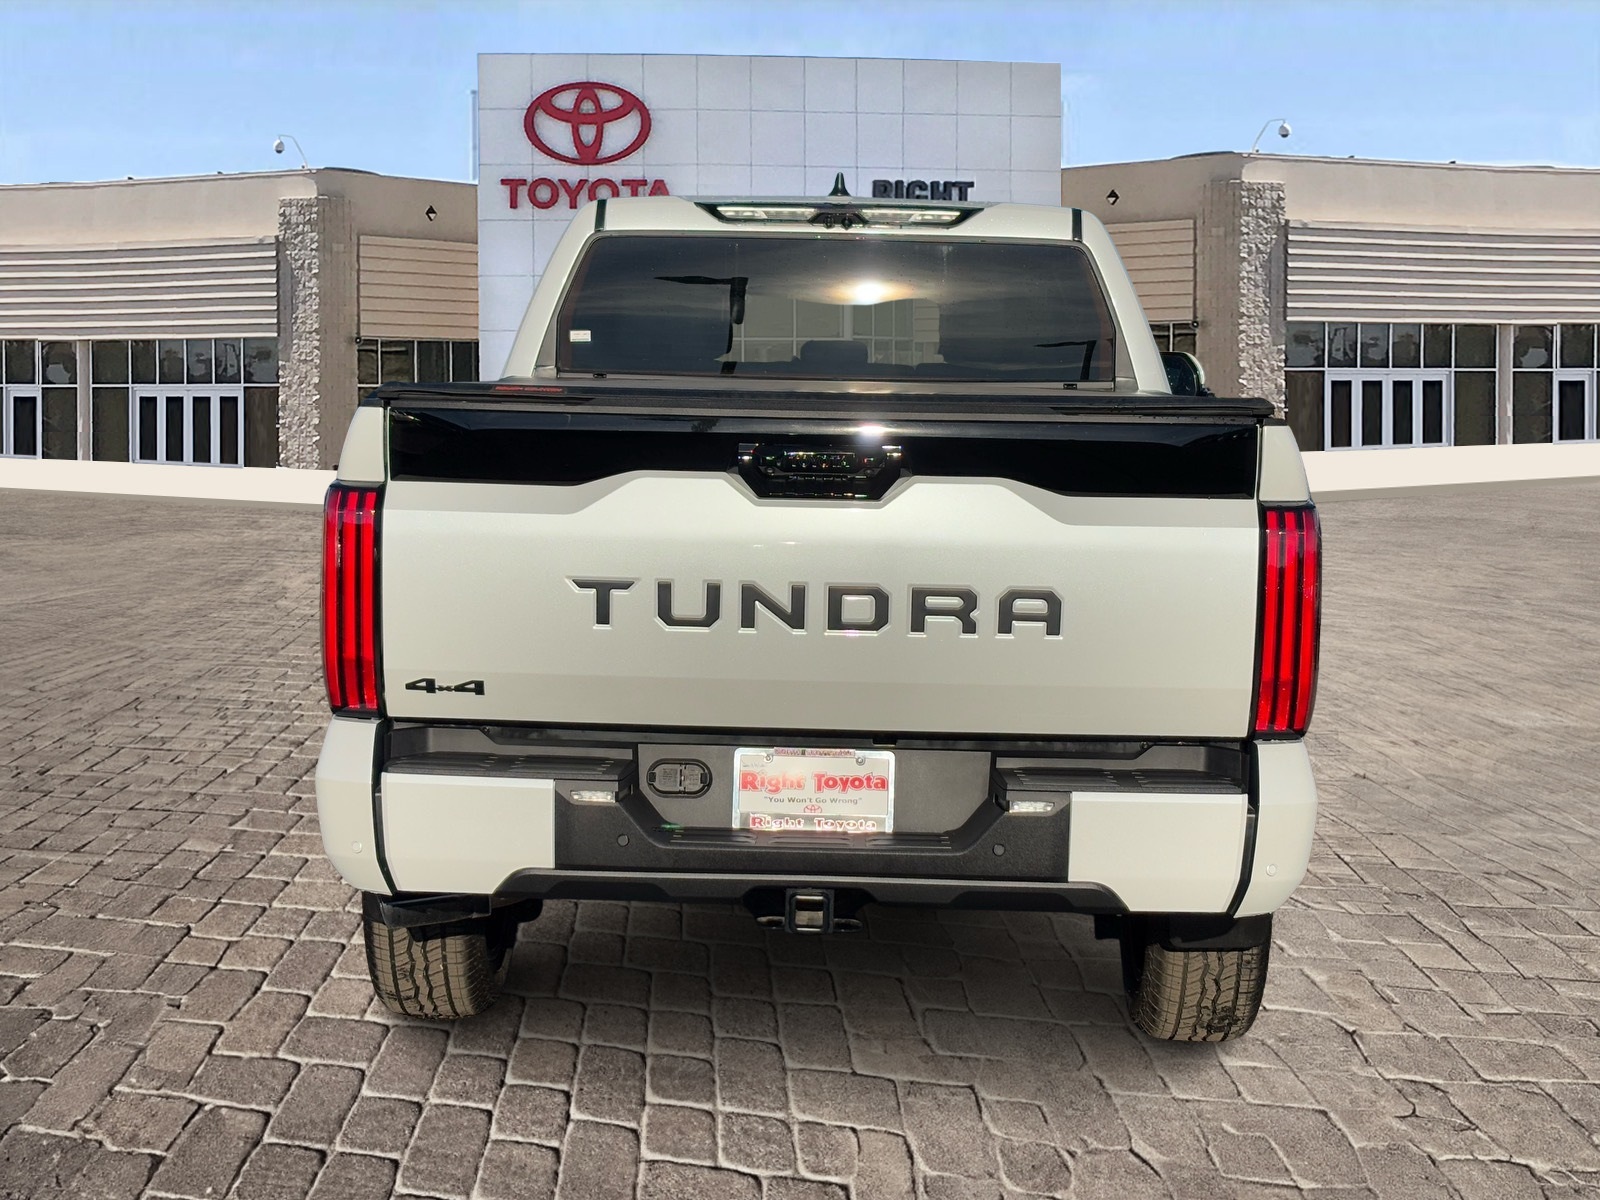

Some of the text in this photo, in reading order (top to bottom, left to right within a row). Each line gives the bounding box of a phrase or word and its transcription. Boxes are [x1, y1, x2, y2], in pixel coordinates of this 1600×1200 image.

[500, 178, 670, 209] TOYOTA
[872, 179, 975, 201] RIGHT
[568, 577, 1064, 640] TUNDRA
[740, 771, 888, 795] Right Toyota
[750, 815, 877, 831] Right Toyota
